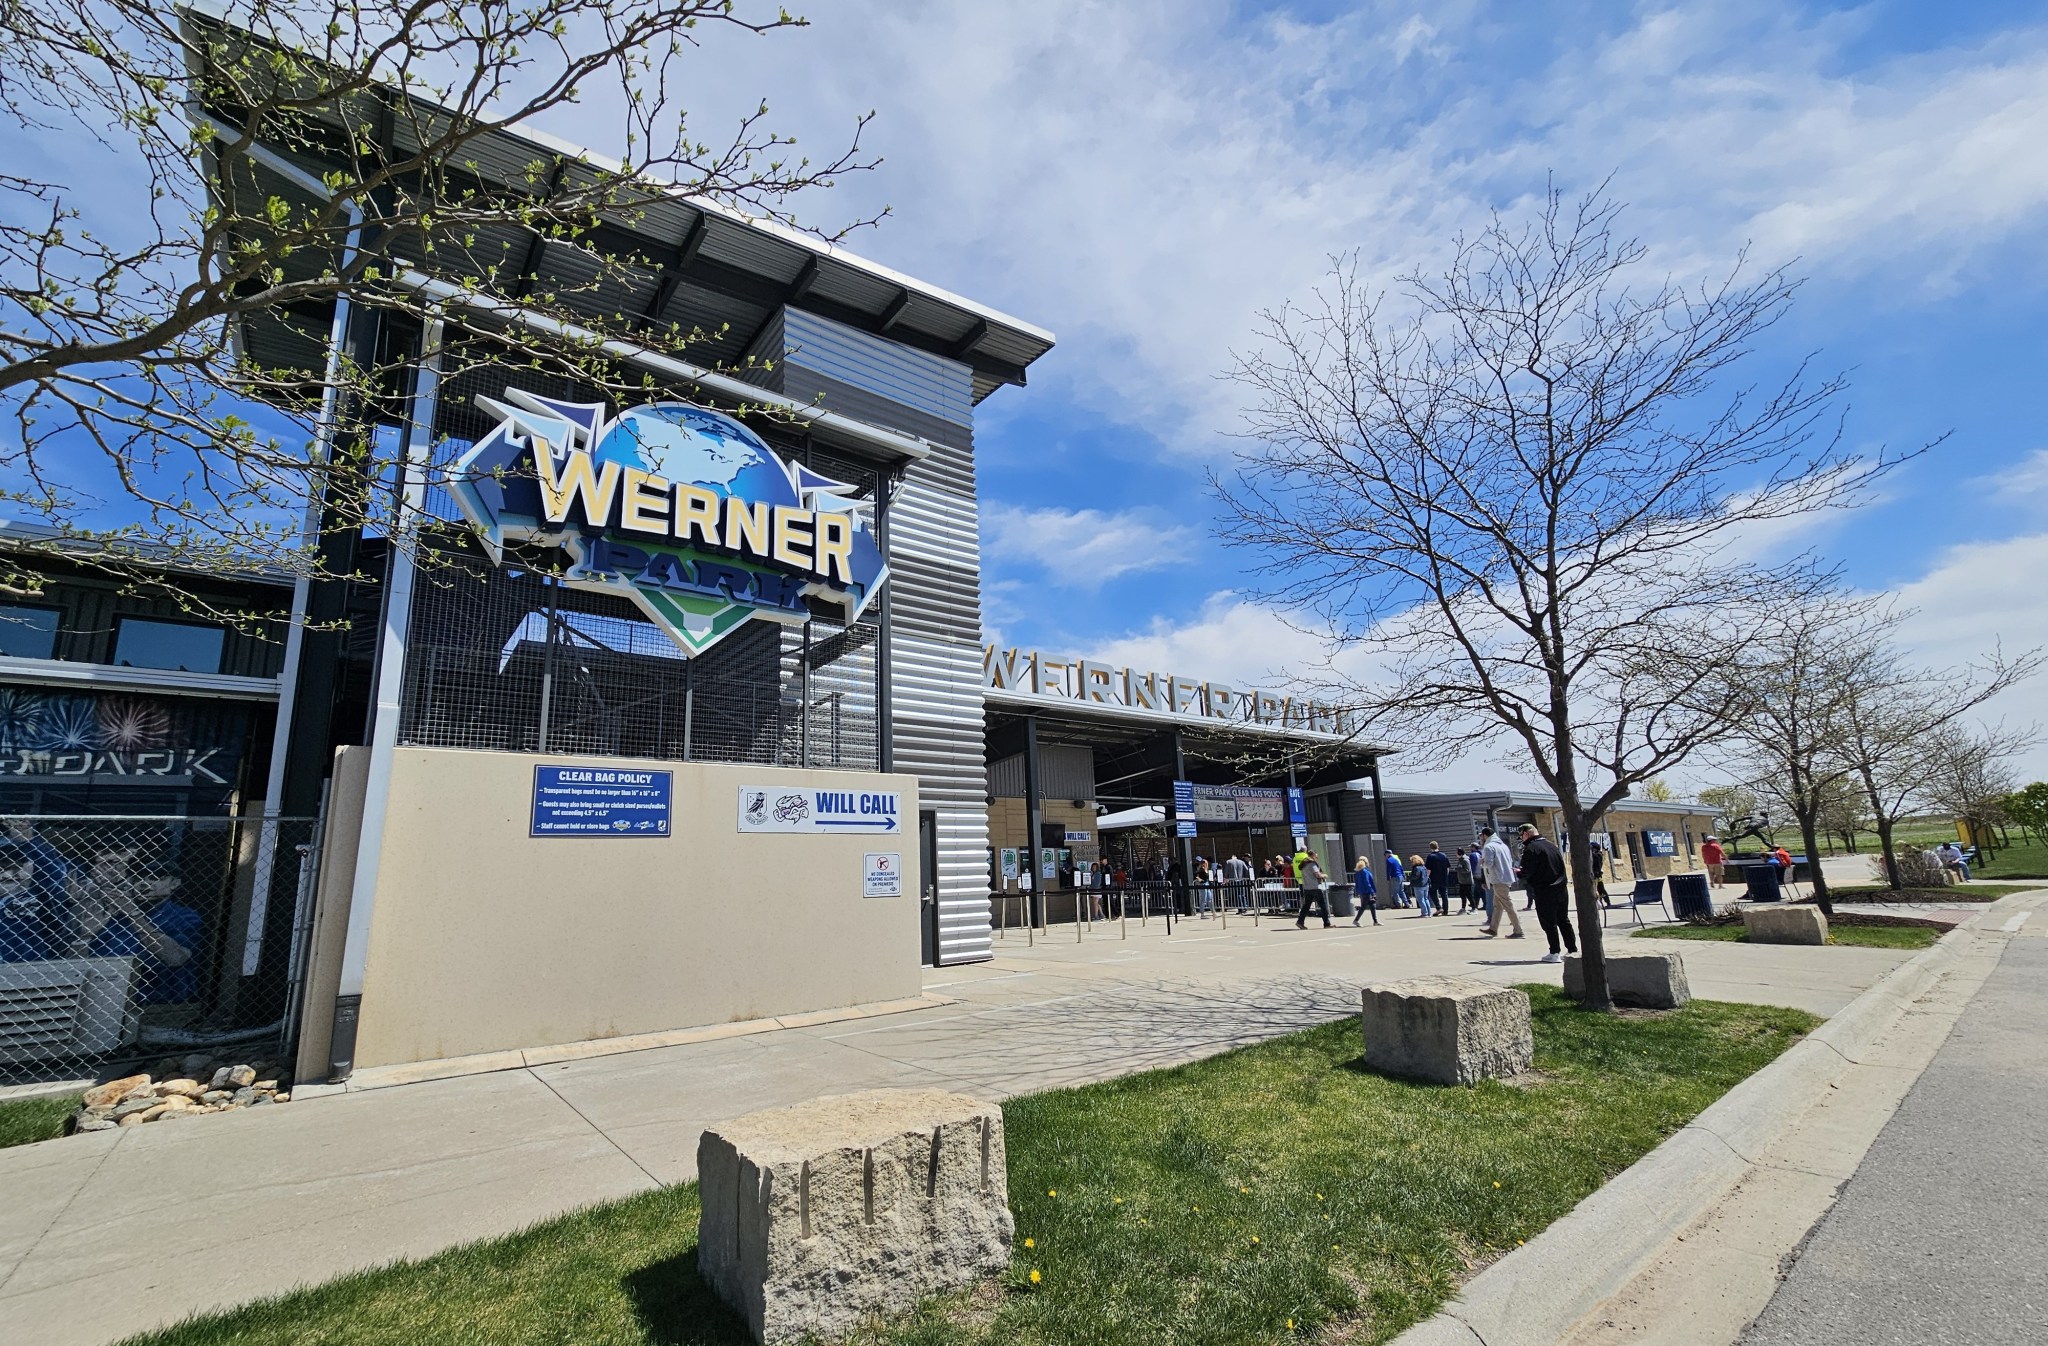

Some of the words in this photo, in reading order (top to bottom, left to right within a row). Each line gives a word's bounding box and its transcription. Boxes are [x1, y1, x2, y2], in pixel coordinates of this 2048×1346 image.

[531, 433, 854, 585] WERNER
[579, 536, 810, 613] PARK
[982, 644, 1234, 719] WERNER
[558, 770, 593, 782] CLEAR
[595, 772, 615, 783] BAG
[618, 773, 652, 784] POLICY
[543, 787, 571, 795] Transparent
[1193, 787, 1214, 796] ERNER
[1214, 788, 1231, 797] PARK
[1232, 788, 1250, 797] CLEAR
[1250, 790, 1263, 798] BAG
[1263, 790, 1282, 798] POLICY
[1290, 788, 1301, 798] GATE
[816, 792, 856, 813] WILL
[860, 794, 897, 815] CALL
[1294, 799, 1299, 813] 1
[541, 822, 553, 830] Staff
[1066, 832, 1077, 840] WILL
[1077, 832, 1087, 840] CALL
